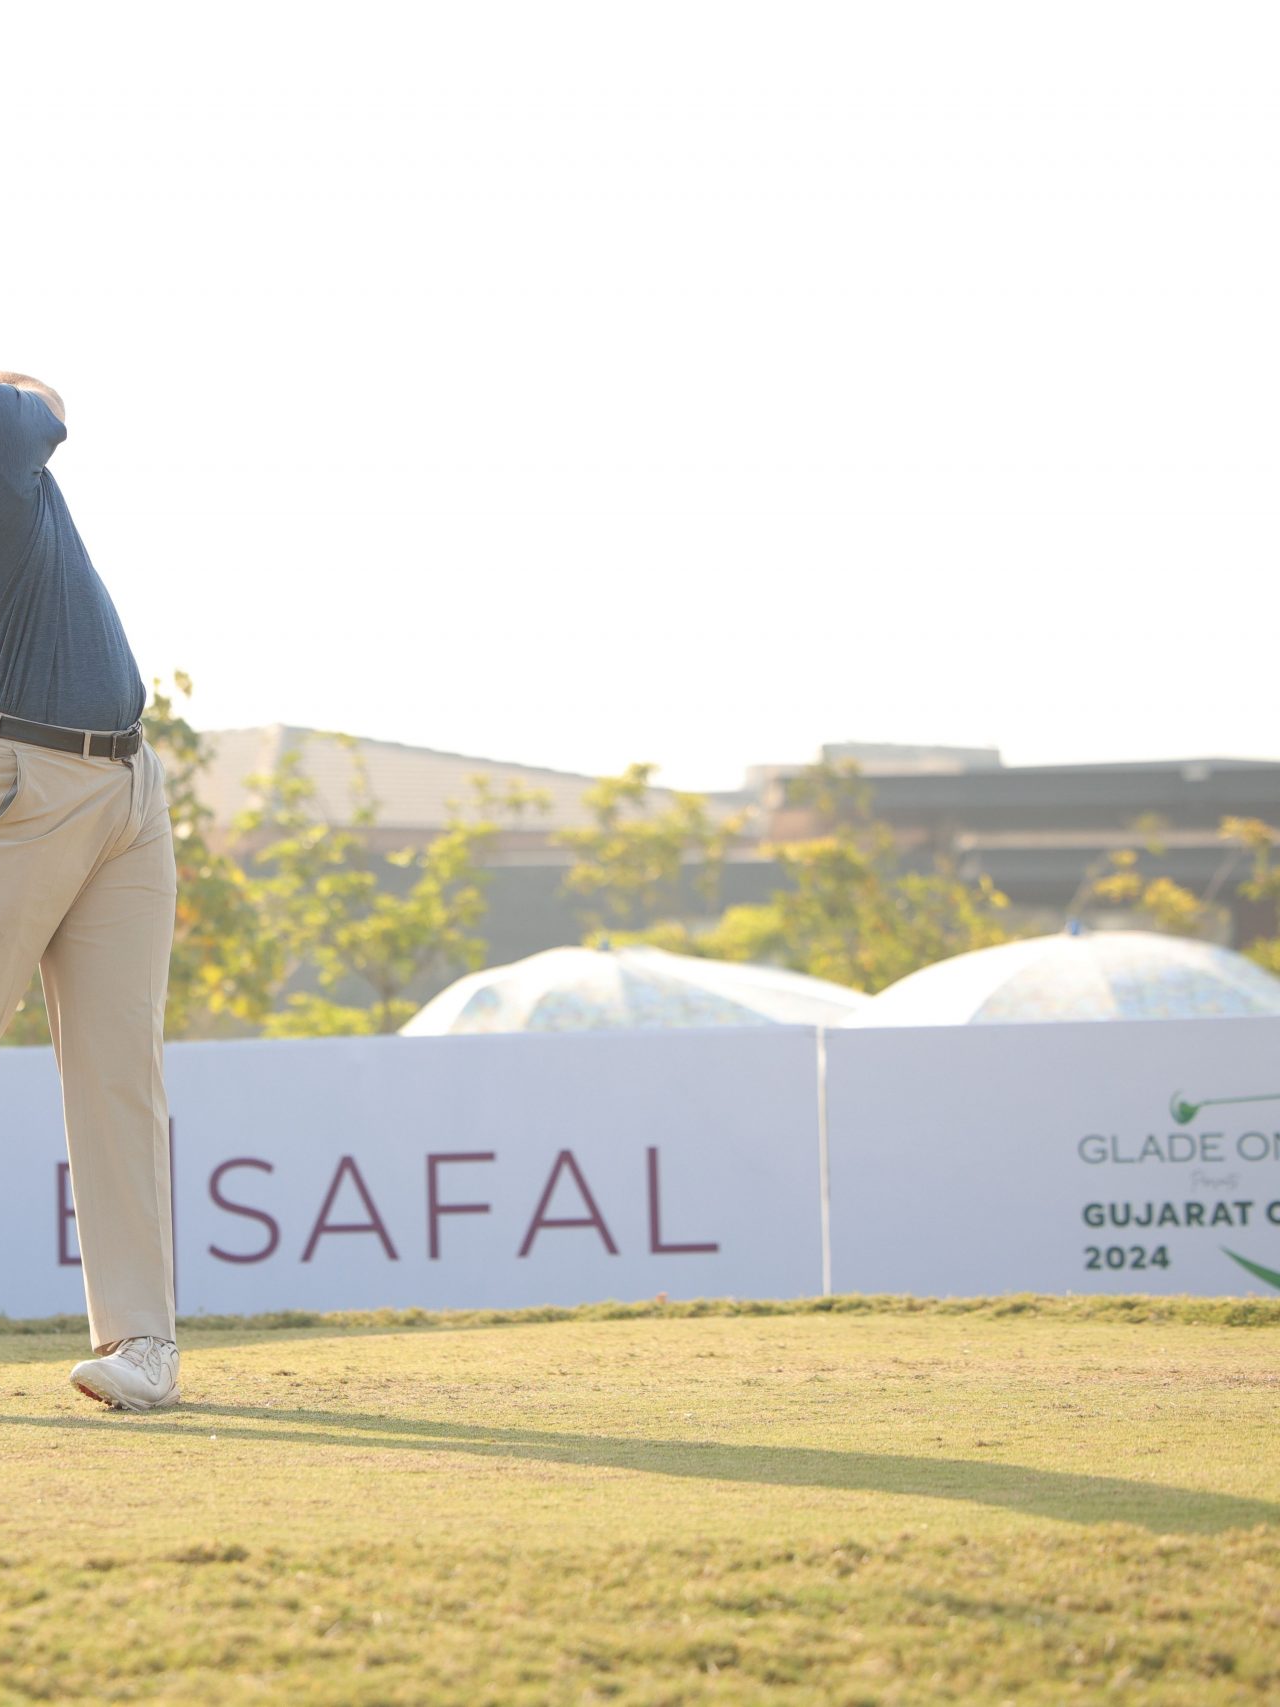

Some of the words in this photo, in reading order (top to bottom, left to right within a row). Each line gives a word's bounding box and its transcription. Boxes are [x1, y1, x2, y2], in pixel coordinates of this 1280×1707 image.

[1077, 1132, 1226, 1165] GLADE
[1082, 1201, 1253, 1228] GUJARAT
[1084, 1246, 1171, 1270] 2024
